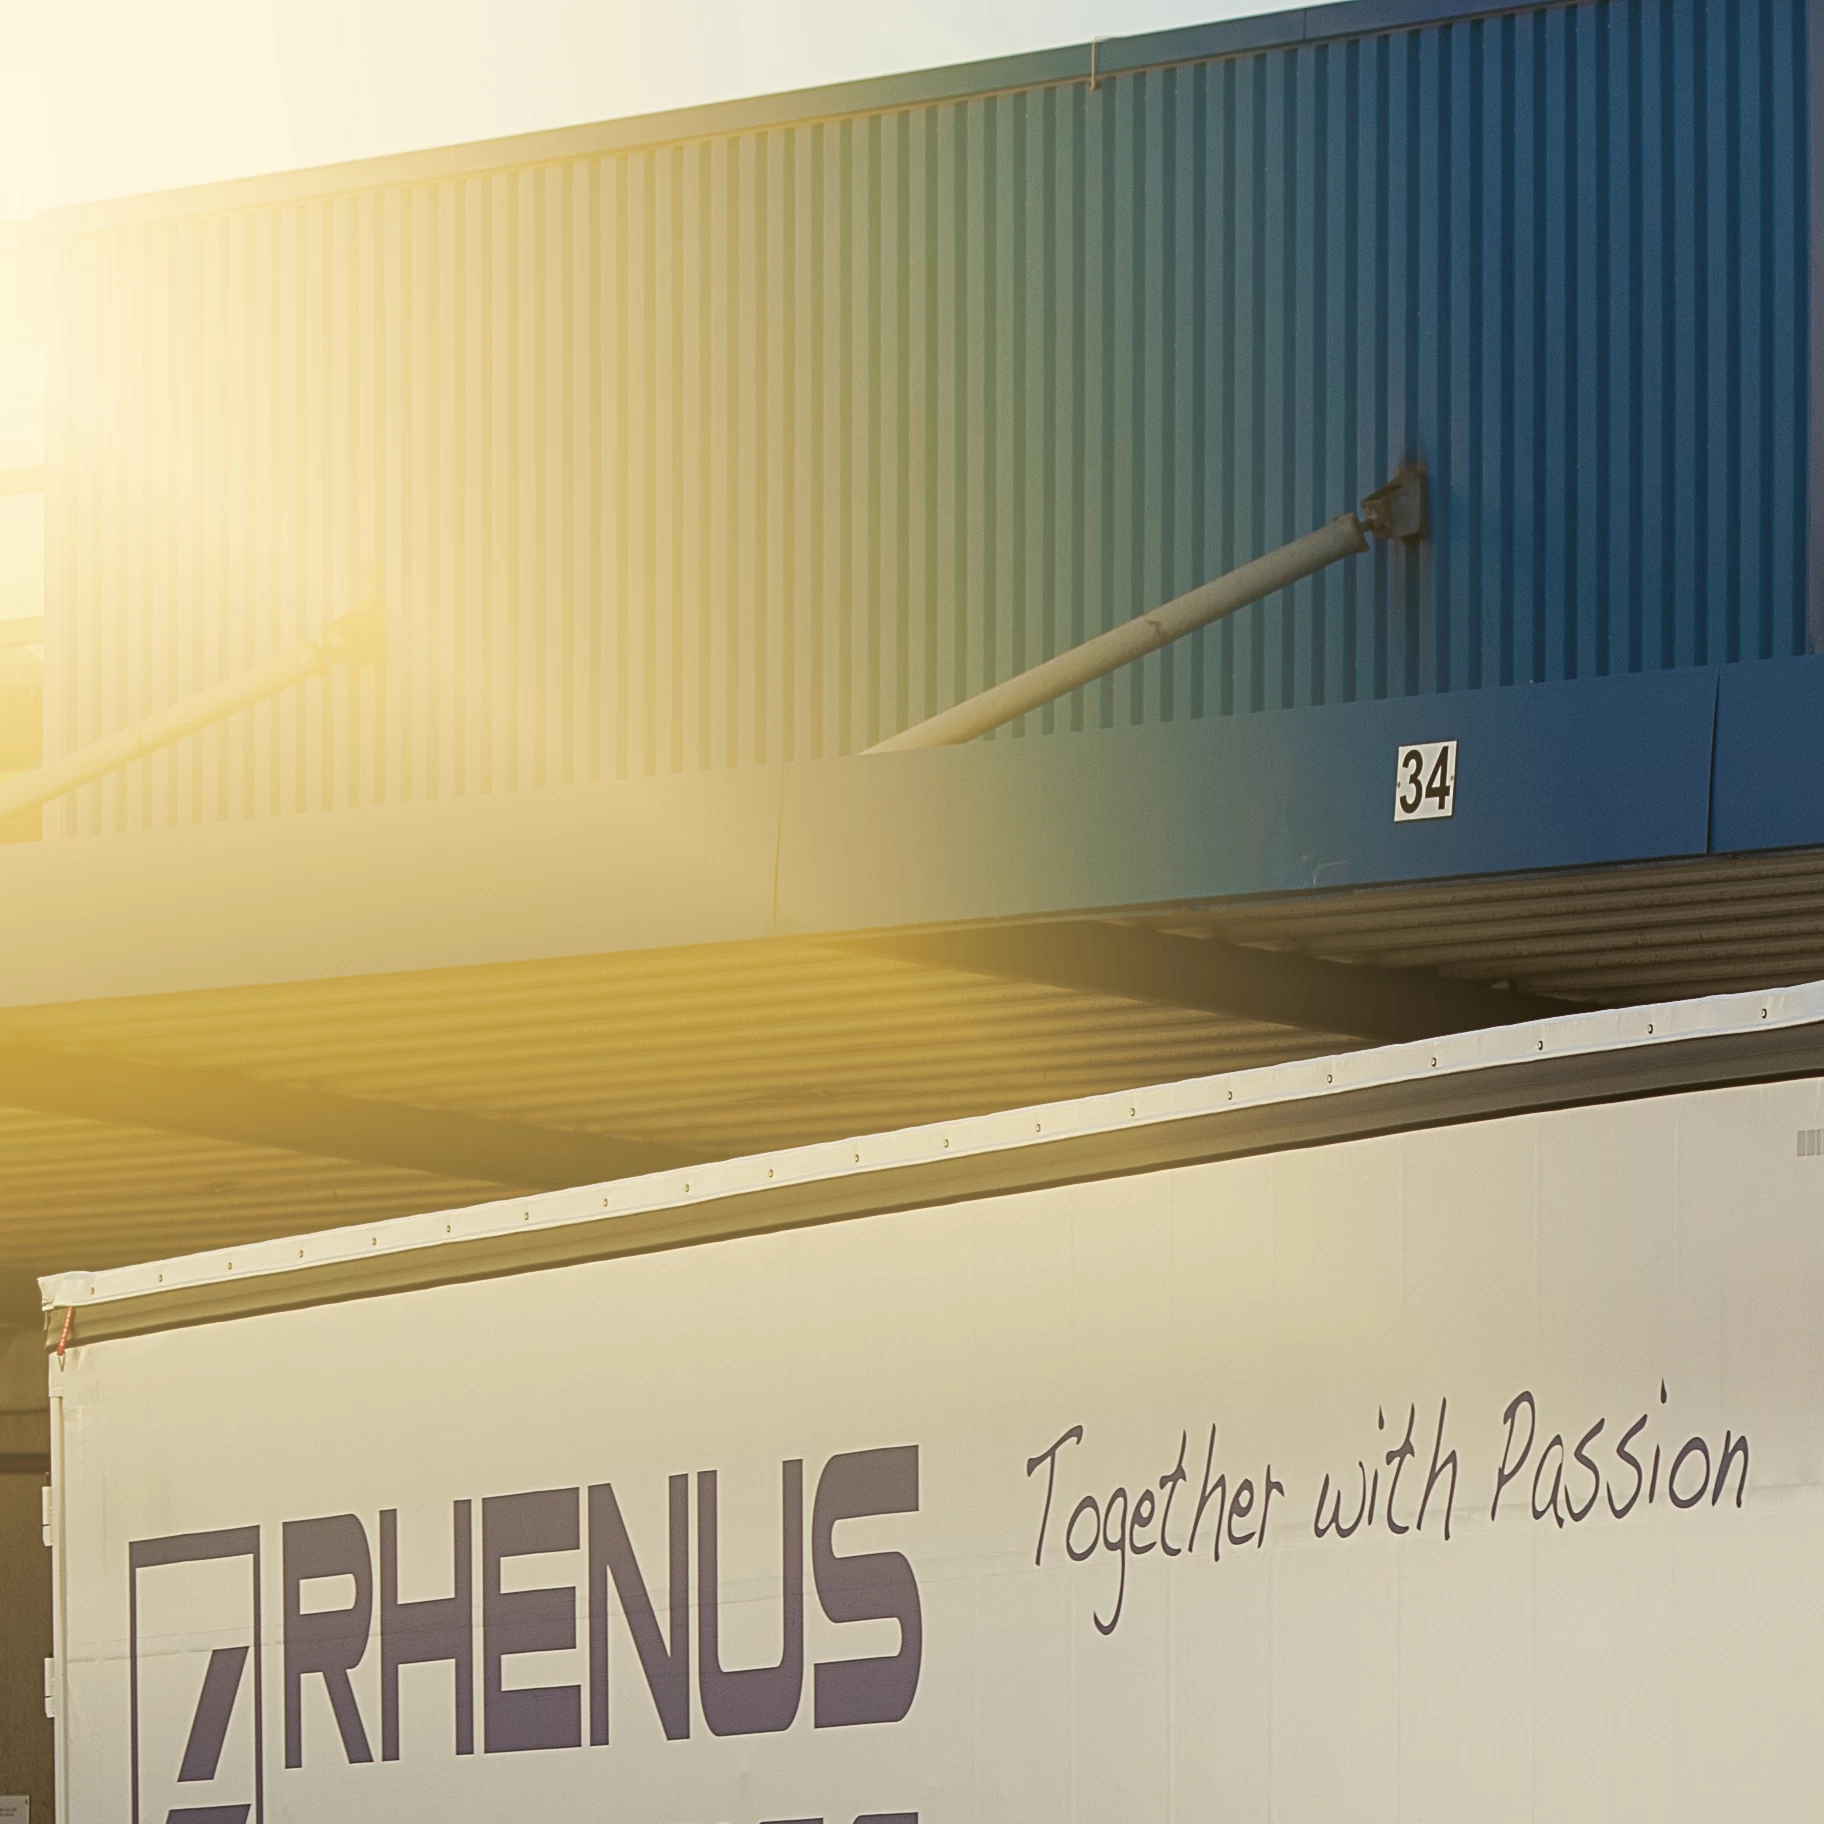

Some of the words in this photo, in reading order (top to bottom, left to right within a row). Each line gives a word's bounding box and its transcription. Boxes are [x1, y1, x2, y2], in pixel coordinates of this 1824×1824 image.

[1399, 745, 1451, 814] 34
[281, 1444, 923, 1770] RHENUS
[1026, 1422, 1285, 1636] Together
[1313, 1396, 1458, 1541] with
[1491, 1376, 1749, 1529] Passion
